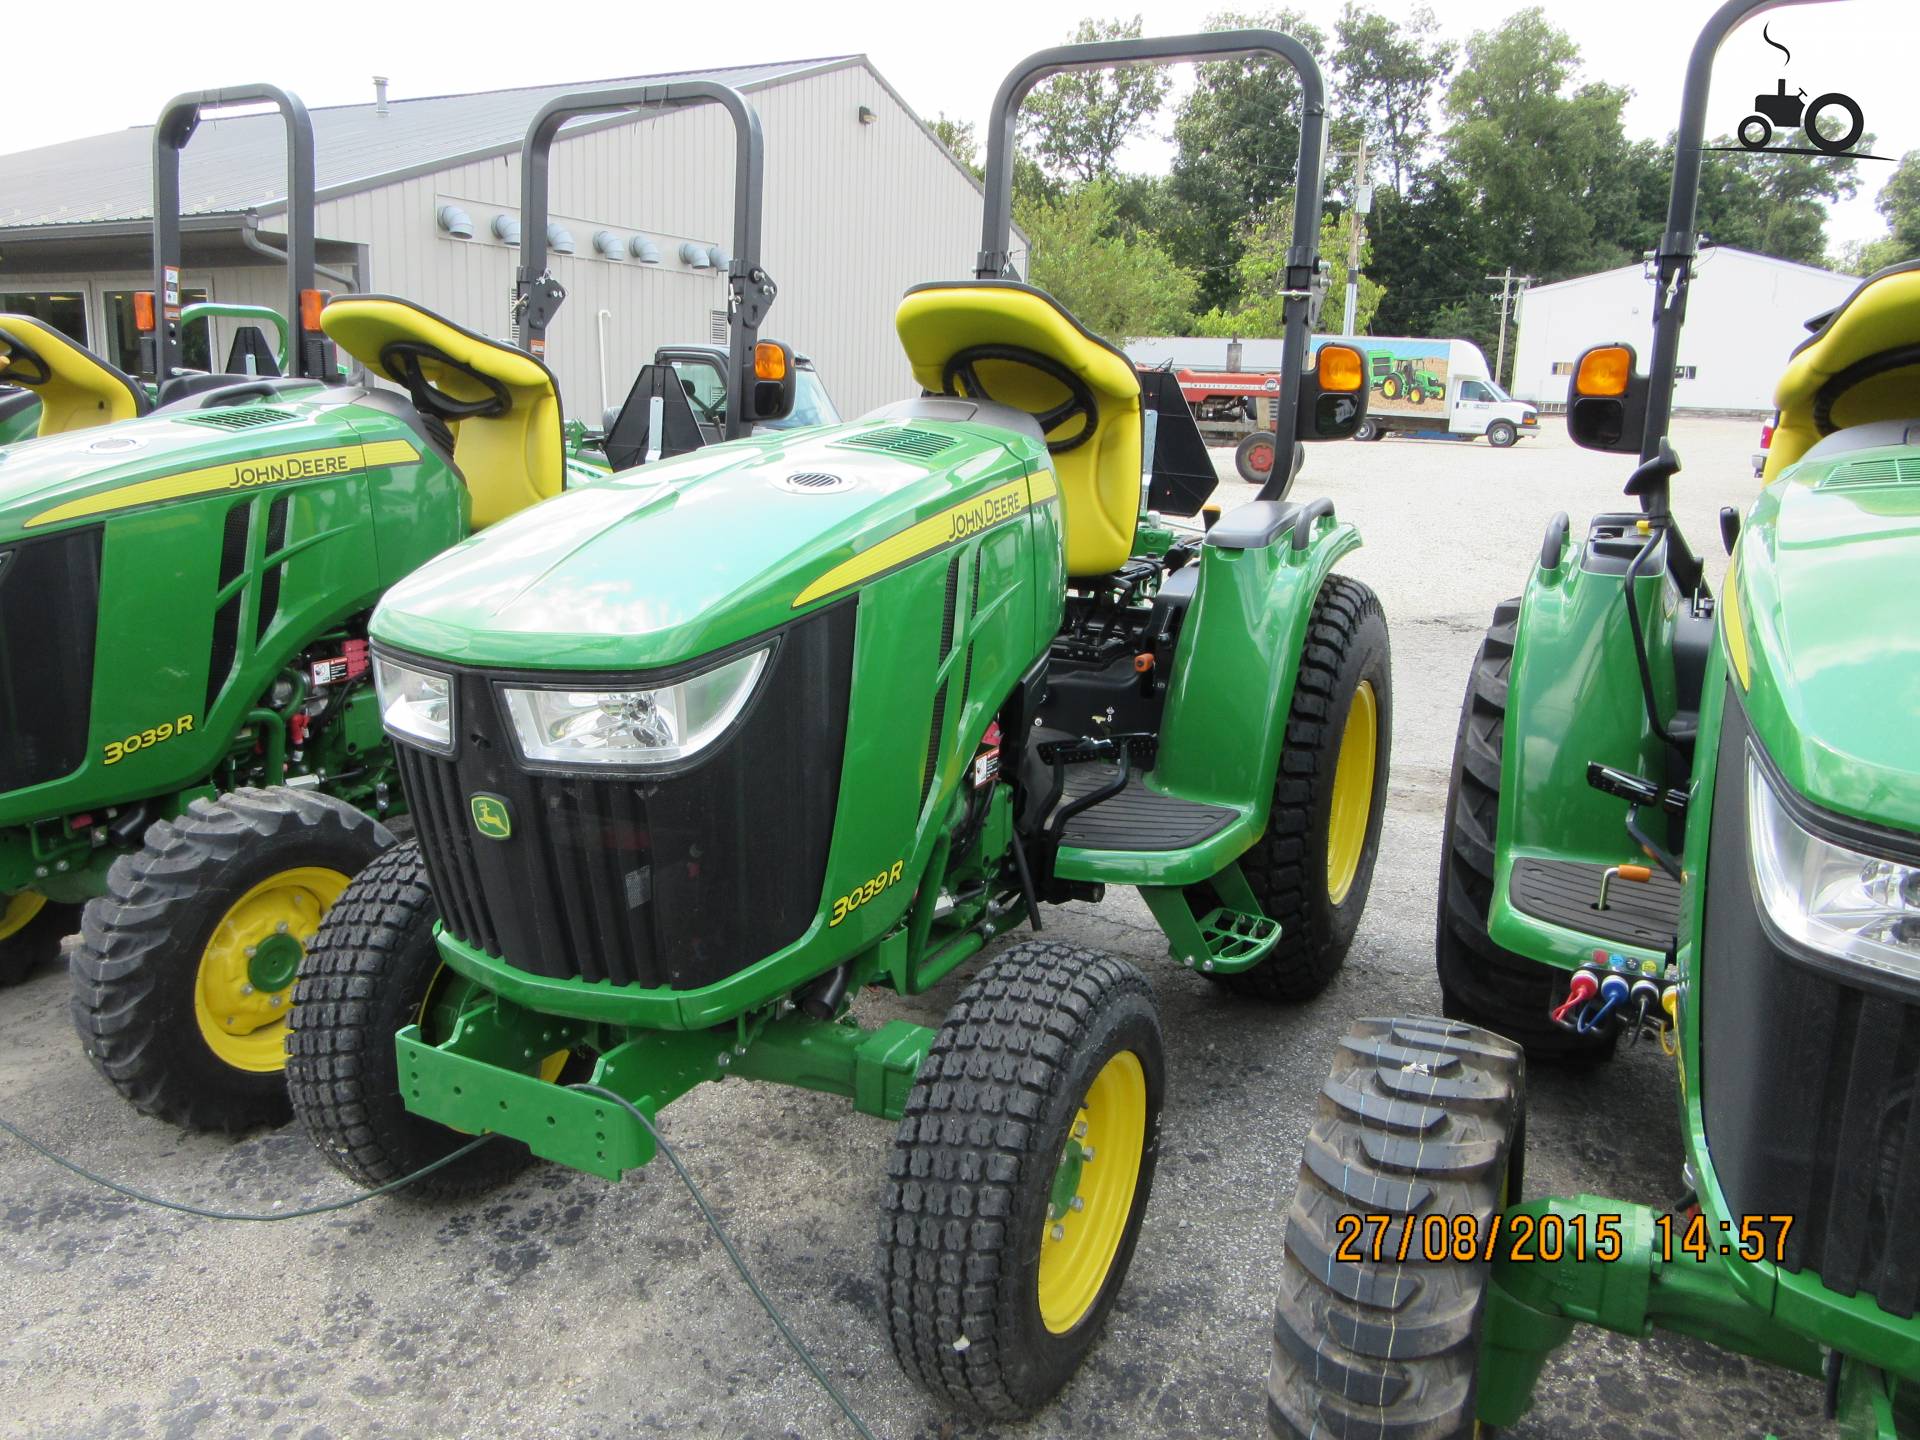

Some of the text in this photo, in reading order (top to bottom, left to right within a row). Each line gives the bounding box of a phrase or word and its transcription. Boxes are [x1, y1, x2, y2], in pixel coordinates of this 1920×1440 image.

[229, 456, 349, 487] JOHN DEERE
[948, 491, 1021, 540] JOHN DEERE
[103, 713, 194, 765] 3039 R
[829, 859, 904, 928] 3039 R
